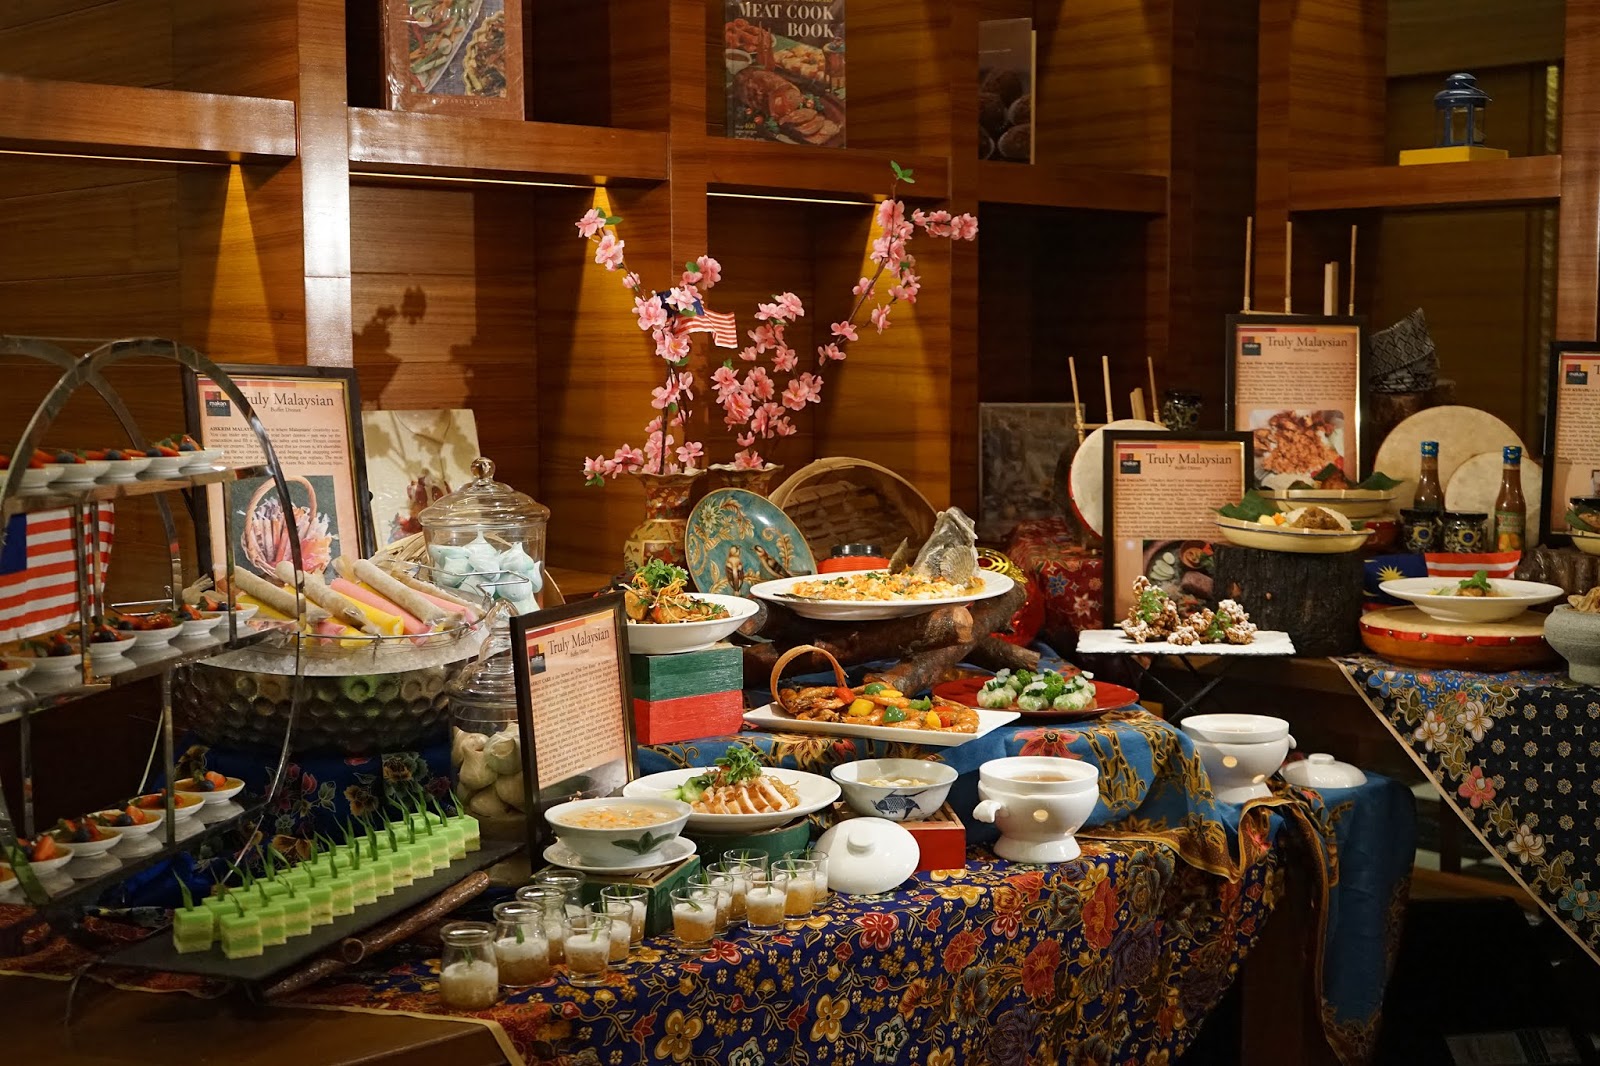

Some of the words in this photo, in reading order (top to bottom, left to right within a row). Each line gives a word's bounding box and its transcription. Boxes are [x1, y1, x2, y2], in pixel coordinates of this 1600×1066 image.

[739, 3, 782, 18] MEAT
[786, 5, 834, 20] COOK
[787, 22, 835, 38] BOOK
[1265, 336, 1292, 350] Truly
[1296, 336, 1348, 350] Malaysian
[242, 392, 270, 409] ruly
[273, 392, 335, 410] Malaysian
[1145, 452, 1175, 468] Truly
[1178, 452, 1232, 468] Malaysian
[547, 636, 570, 655] Truly
[572, 628, 610, 649] Malaysian
